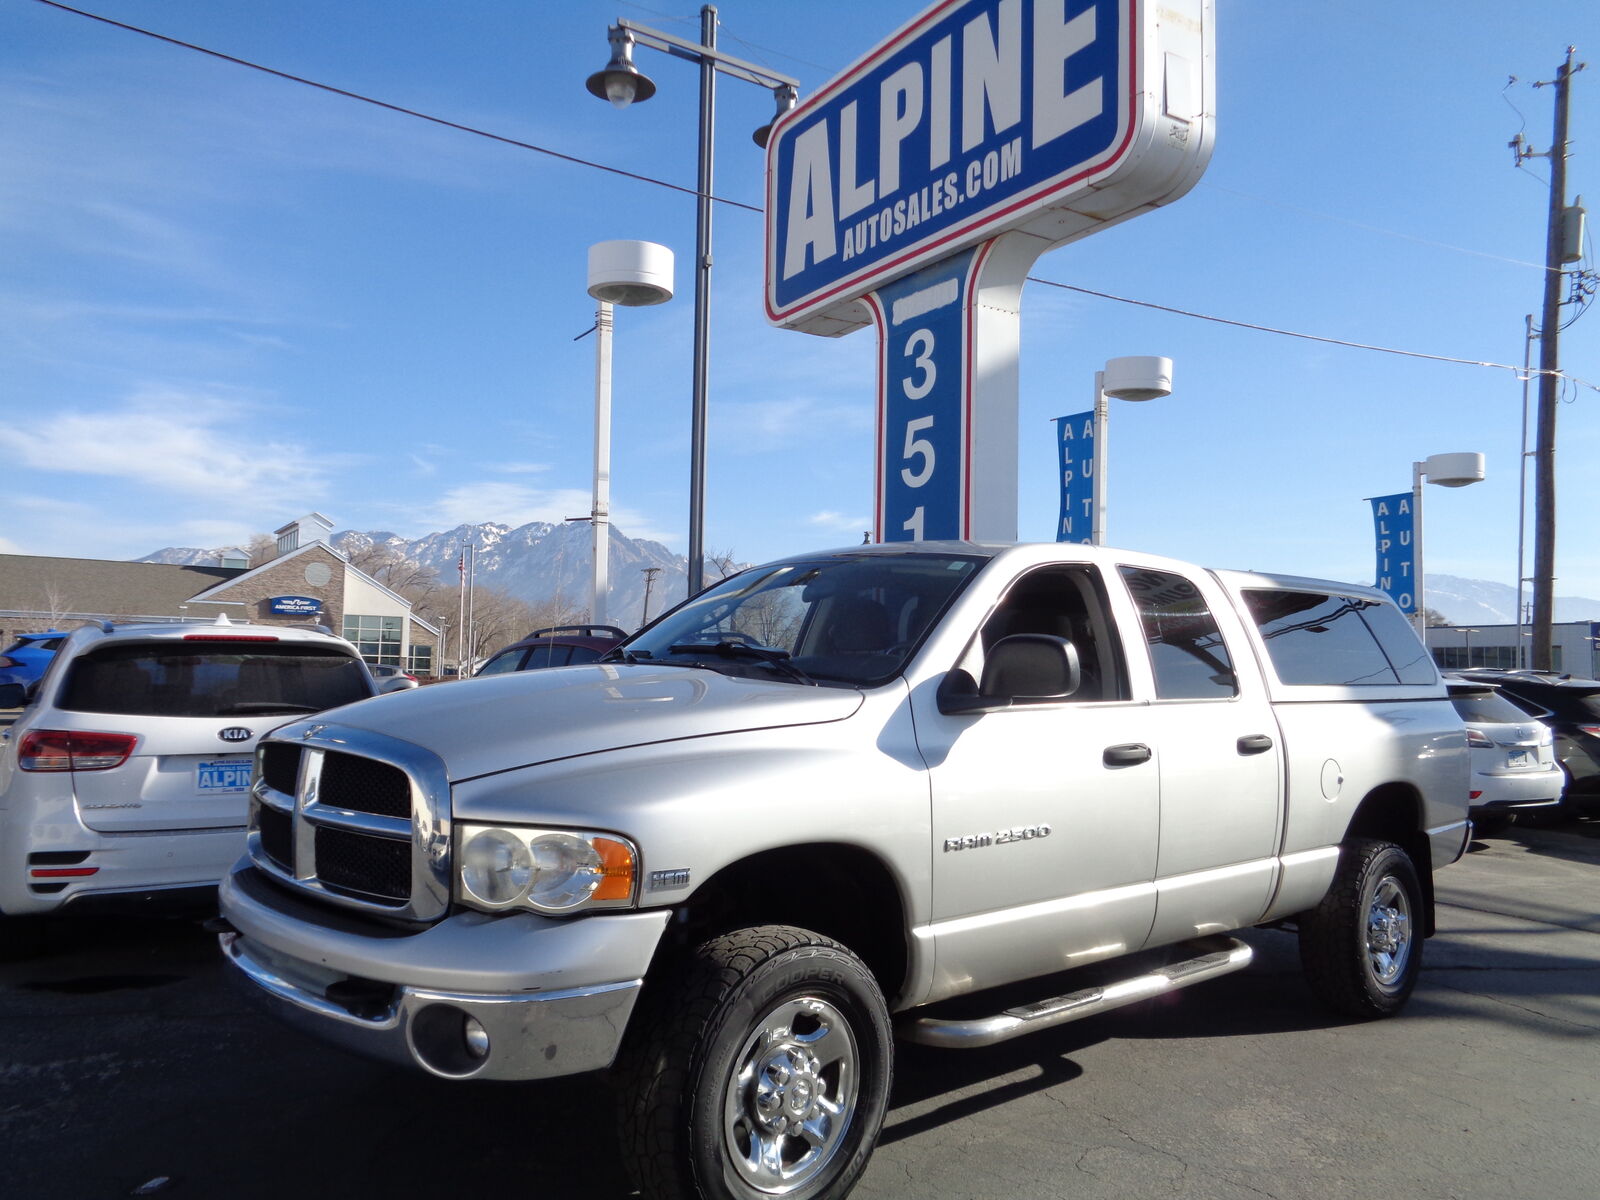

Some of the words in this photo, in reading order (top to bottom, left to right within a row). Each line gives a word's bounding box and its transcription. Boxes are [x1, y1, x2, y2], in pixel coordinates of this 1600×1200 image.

[783, 0, 1104, 281] ALPINE
[842, 136, 1022, 262] AUTOSALES.COM
[1062, 423, 1073, 544] ALPIN
[1377, 502, 1391, 590] ALPIN
[1399, 499, 1411, 608] AUTO
[200, 771, 252, 787] ALPIN
[223, 729, 248, 739] KIA
[944, 835, 992, 853] RAM
[995, 824, 1051, 845] 2500
